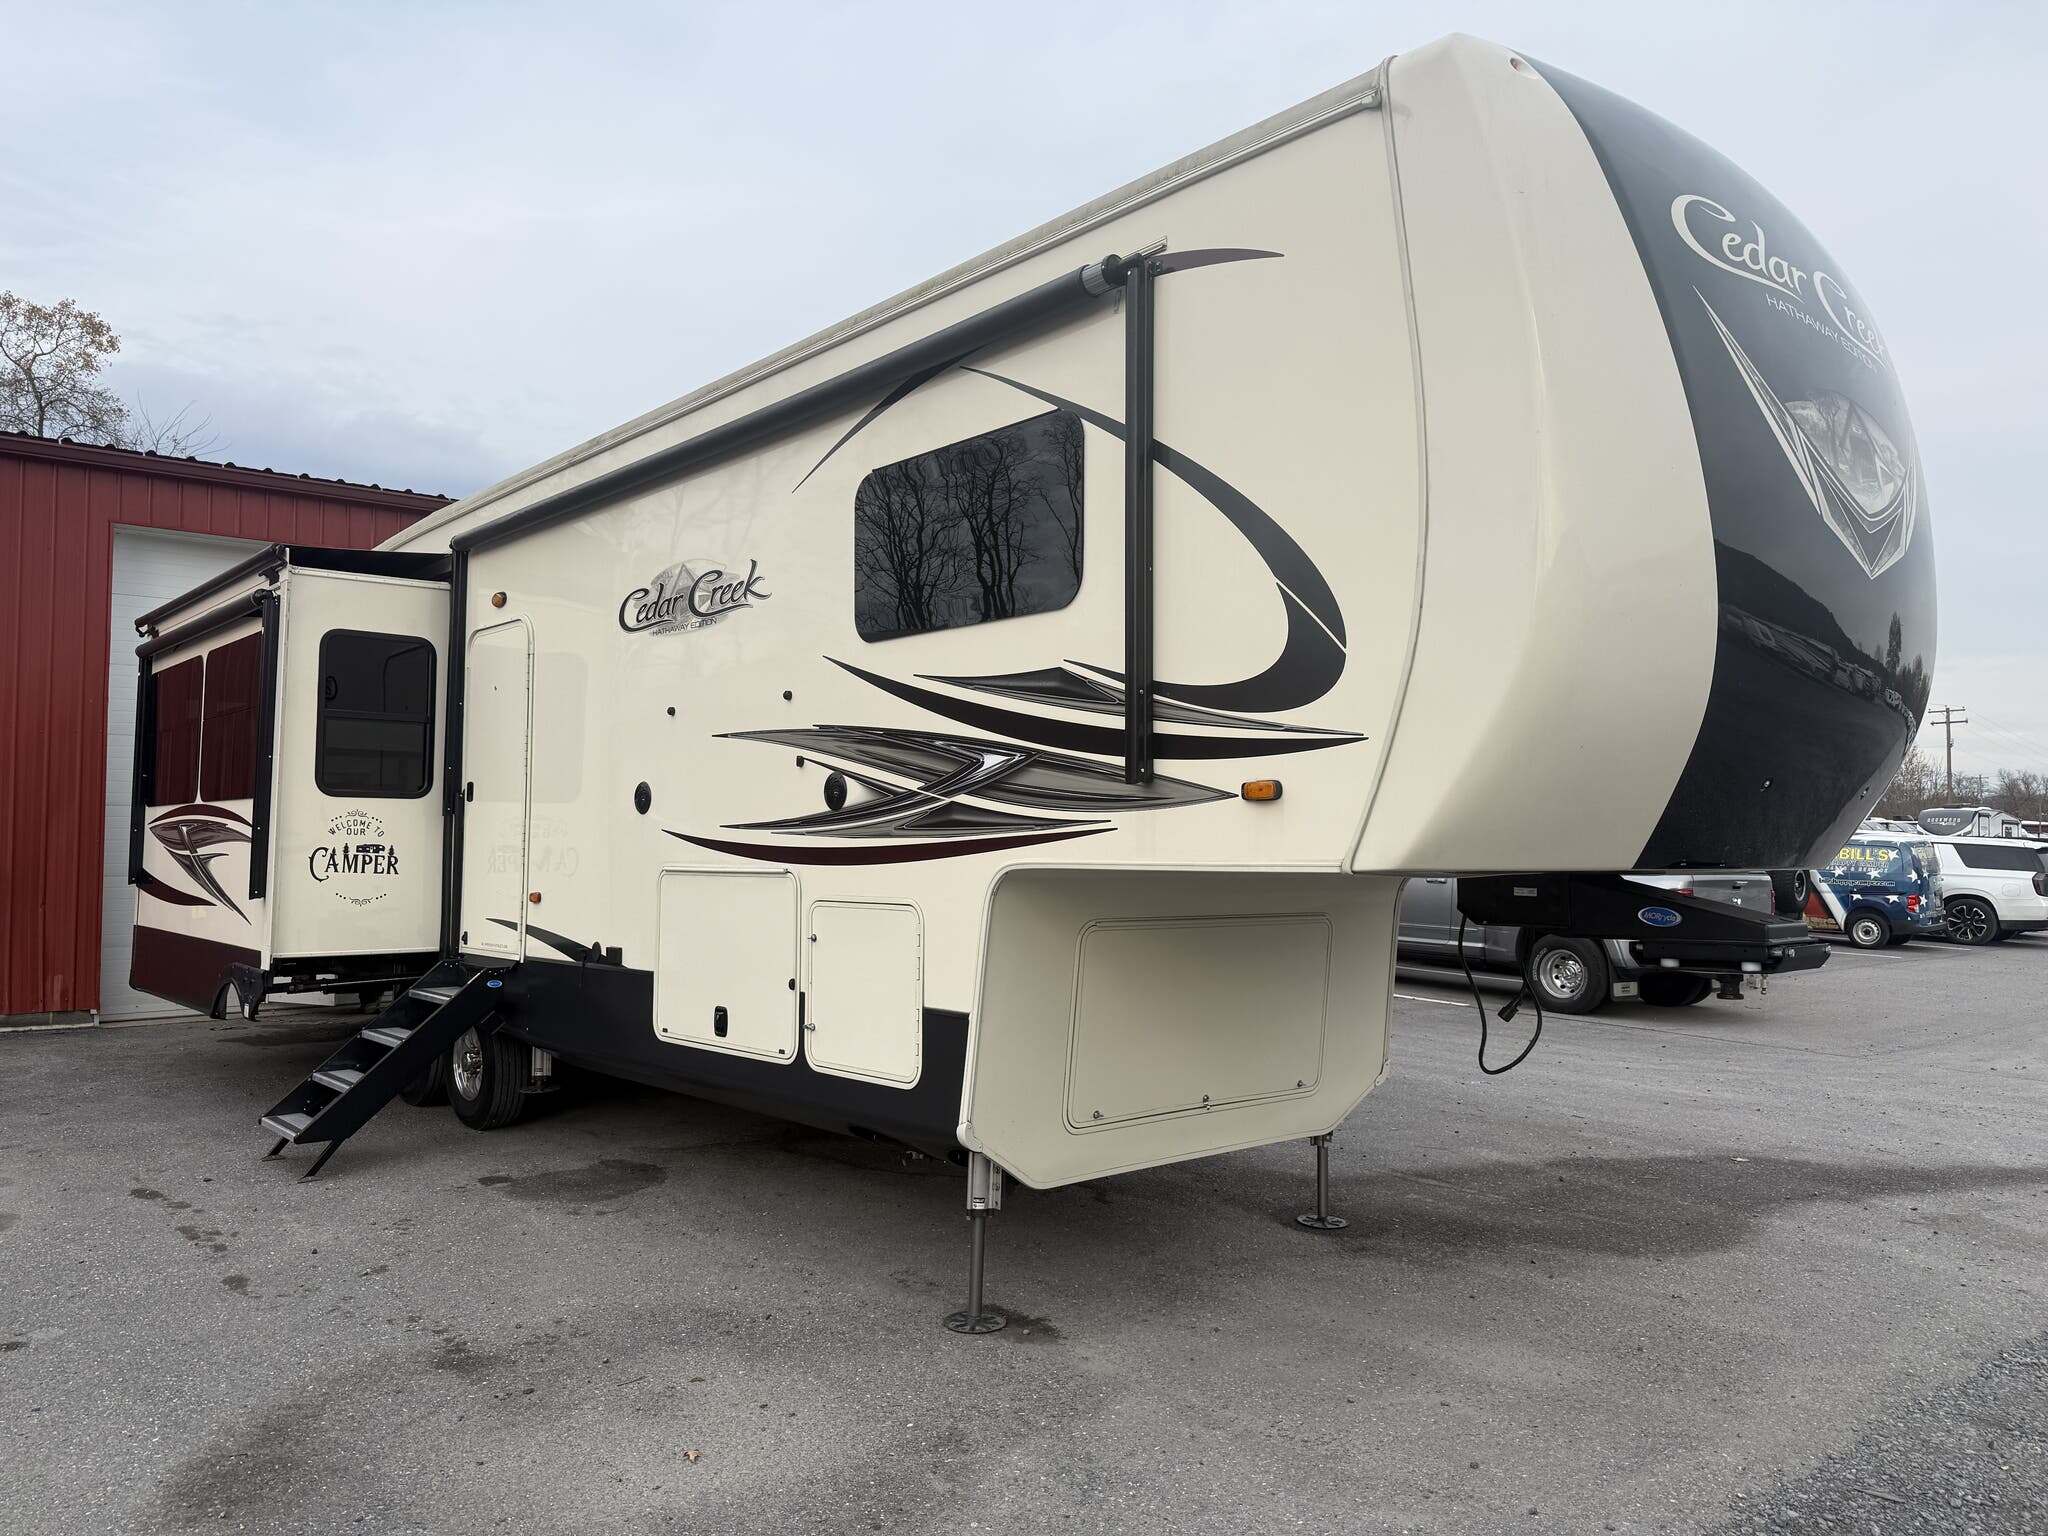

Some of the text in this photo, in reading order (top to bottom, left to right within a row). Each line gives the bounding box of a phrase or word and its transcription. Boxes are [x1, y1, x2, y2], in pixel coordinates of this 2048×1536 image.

[1671, 194, 1889, 370] Cedar Creek
[1765, 293, 1838, 344] HATHAWAY
[619, 559, 773, 633] Cedar Creek
[652, 617, 718, 637] HATHAWAY EDITION
[328, 819, 385, 837] WELCOME TO
[346, 828, 366, 836] OUR
[308, 846, 399, 882] CAMPER
